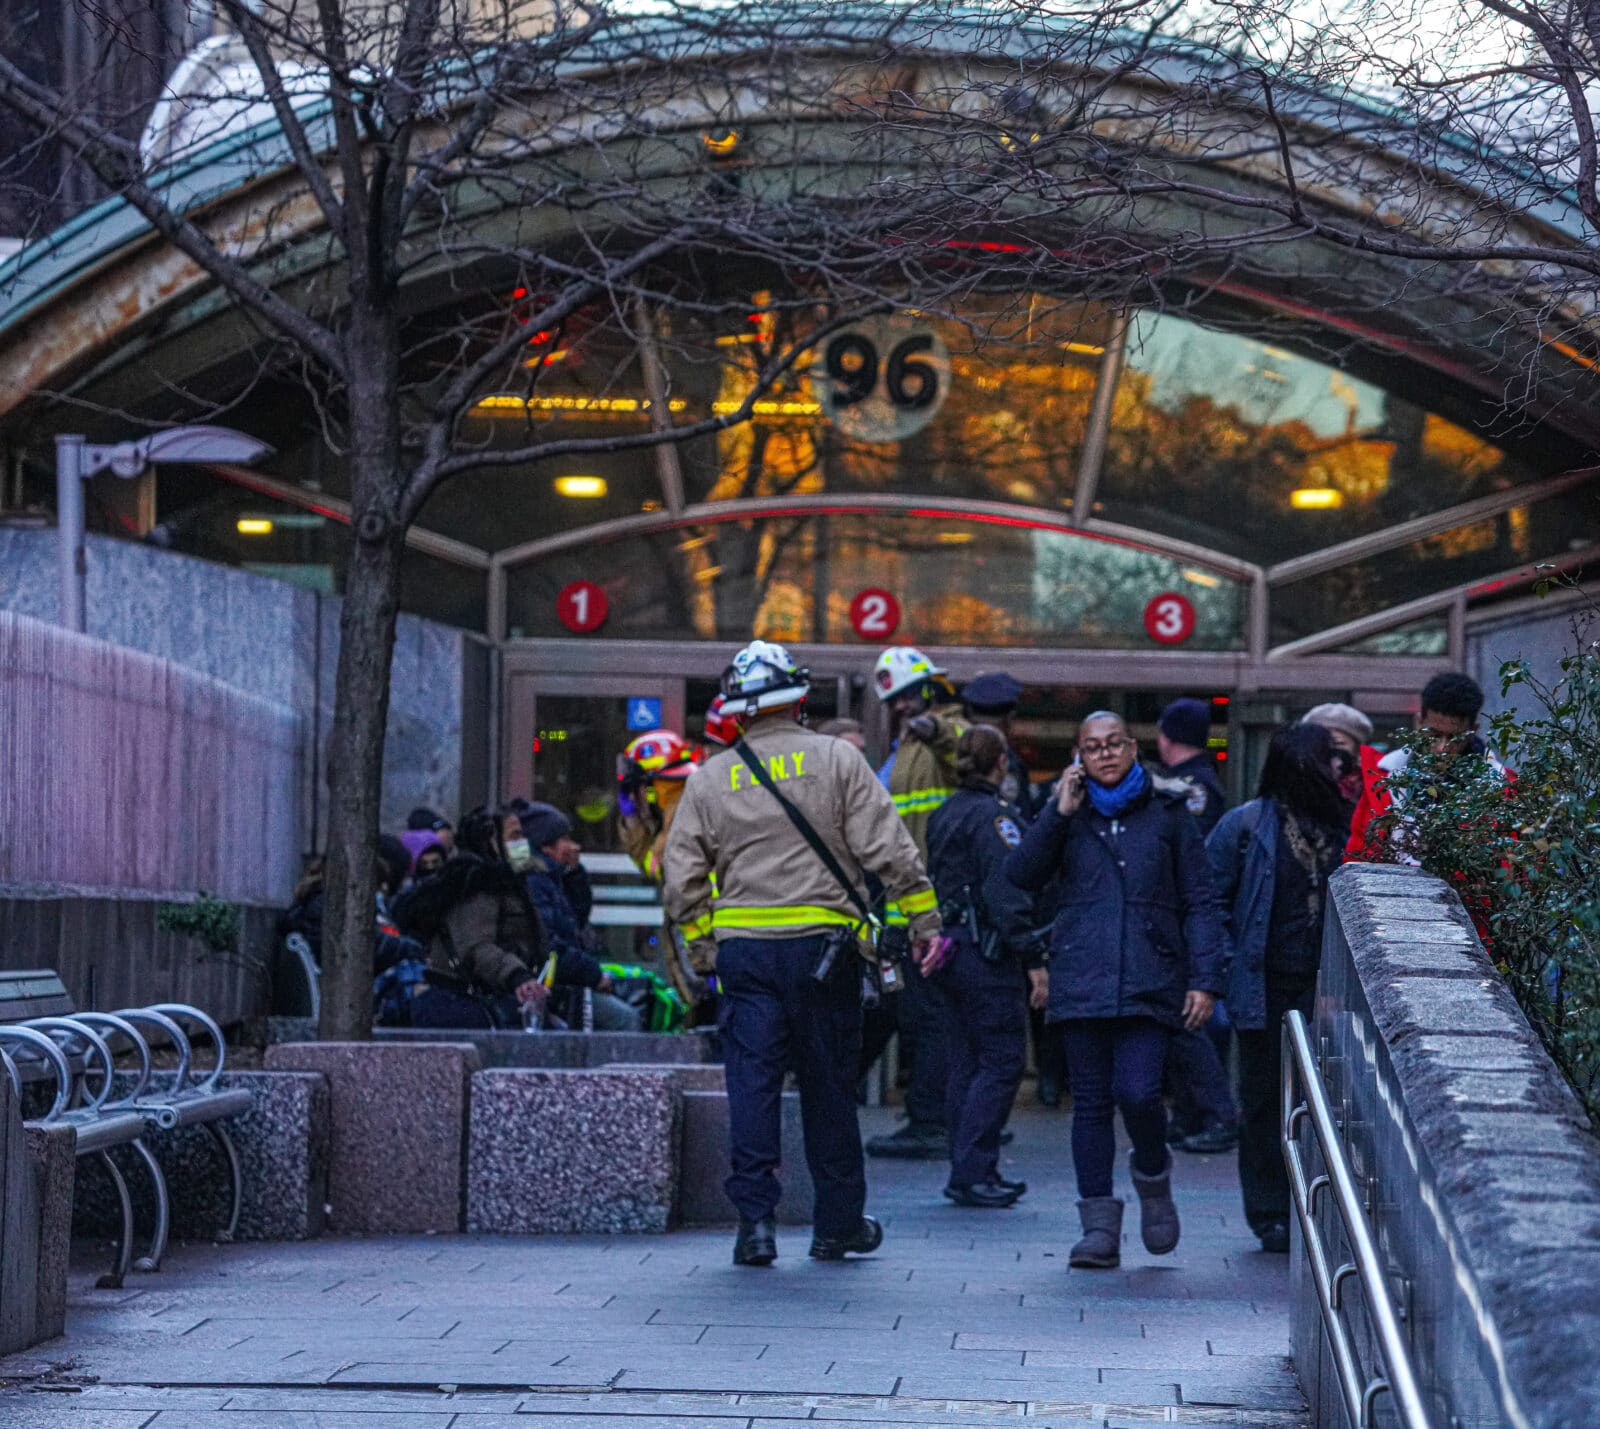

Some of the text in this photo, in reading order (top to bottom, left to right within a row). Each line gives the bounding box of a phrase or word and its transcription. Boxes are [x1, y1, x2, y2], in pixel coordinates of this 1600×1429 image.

[826, 334, 939, 410] 96
[570, 588, 589, 624] 1
[861, 595, 888, 631] 2
[1156, 600, 1183, 636] 3
